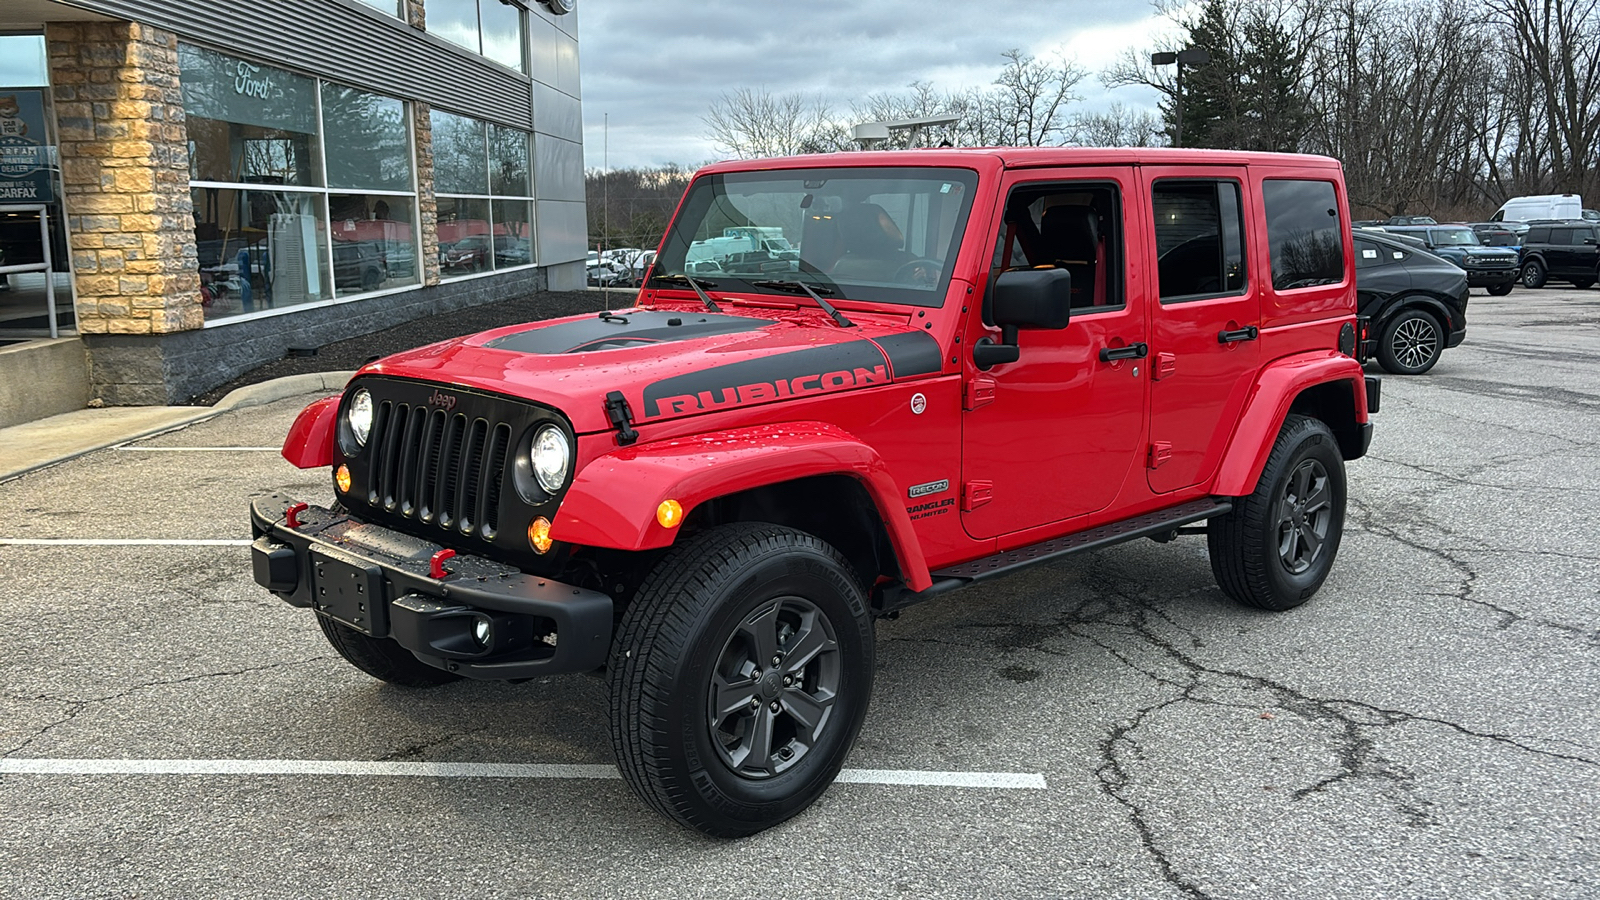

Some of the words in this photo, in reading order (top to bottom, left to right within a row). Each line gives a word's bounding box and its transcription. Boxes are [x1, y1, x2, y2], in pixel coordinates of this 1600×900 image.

[235, 61, 269, 99] Ford
[428, 389, 456, 411] Jeep
[655, 364, 890, 417] RUBICON
[912, 481, 947, 495] RECON
[906, 498, 955, 513] RANGLER
[910, 508, 948, 520] NLIMITED
[811, 562, 862, 614] MICHELIN
